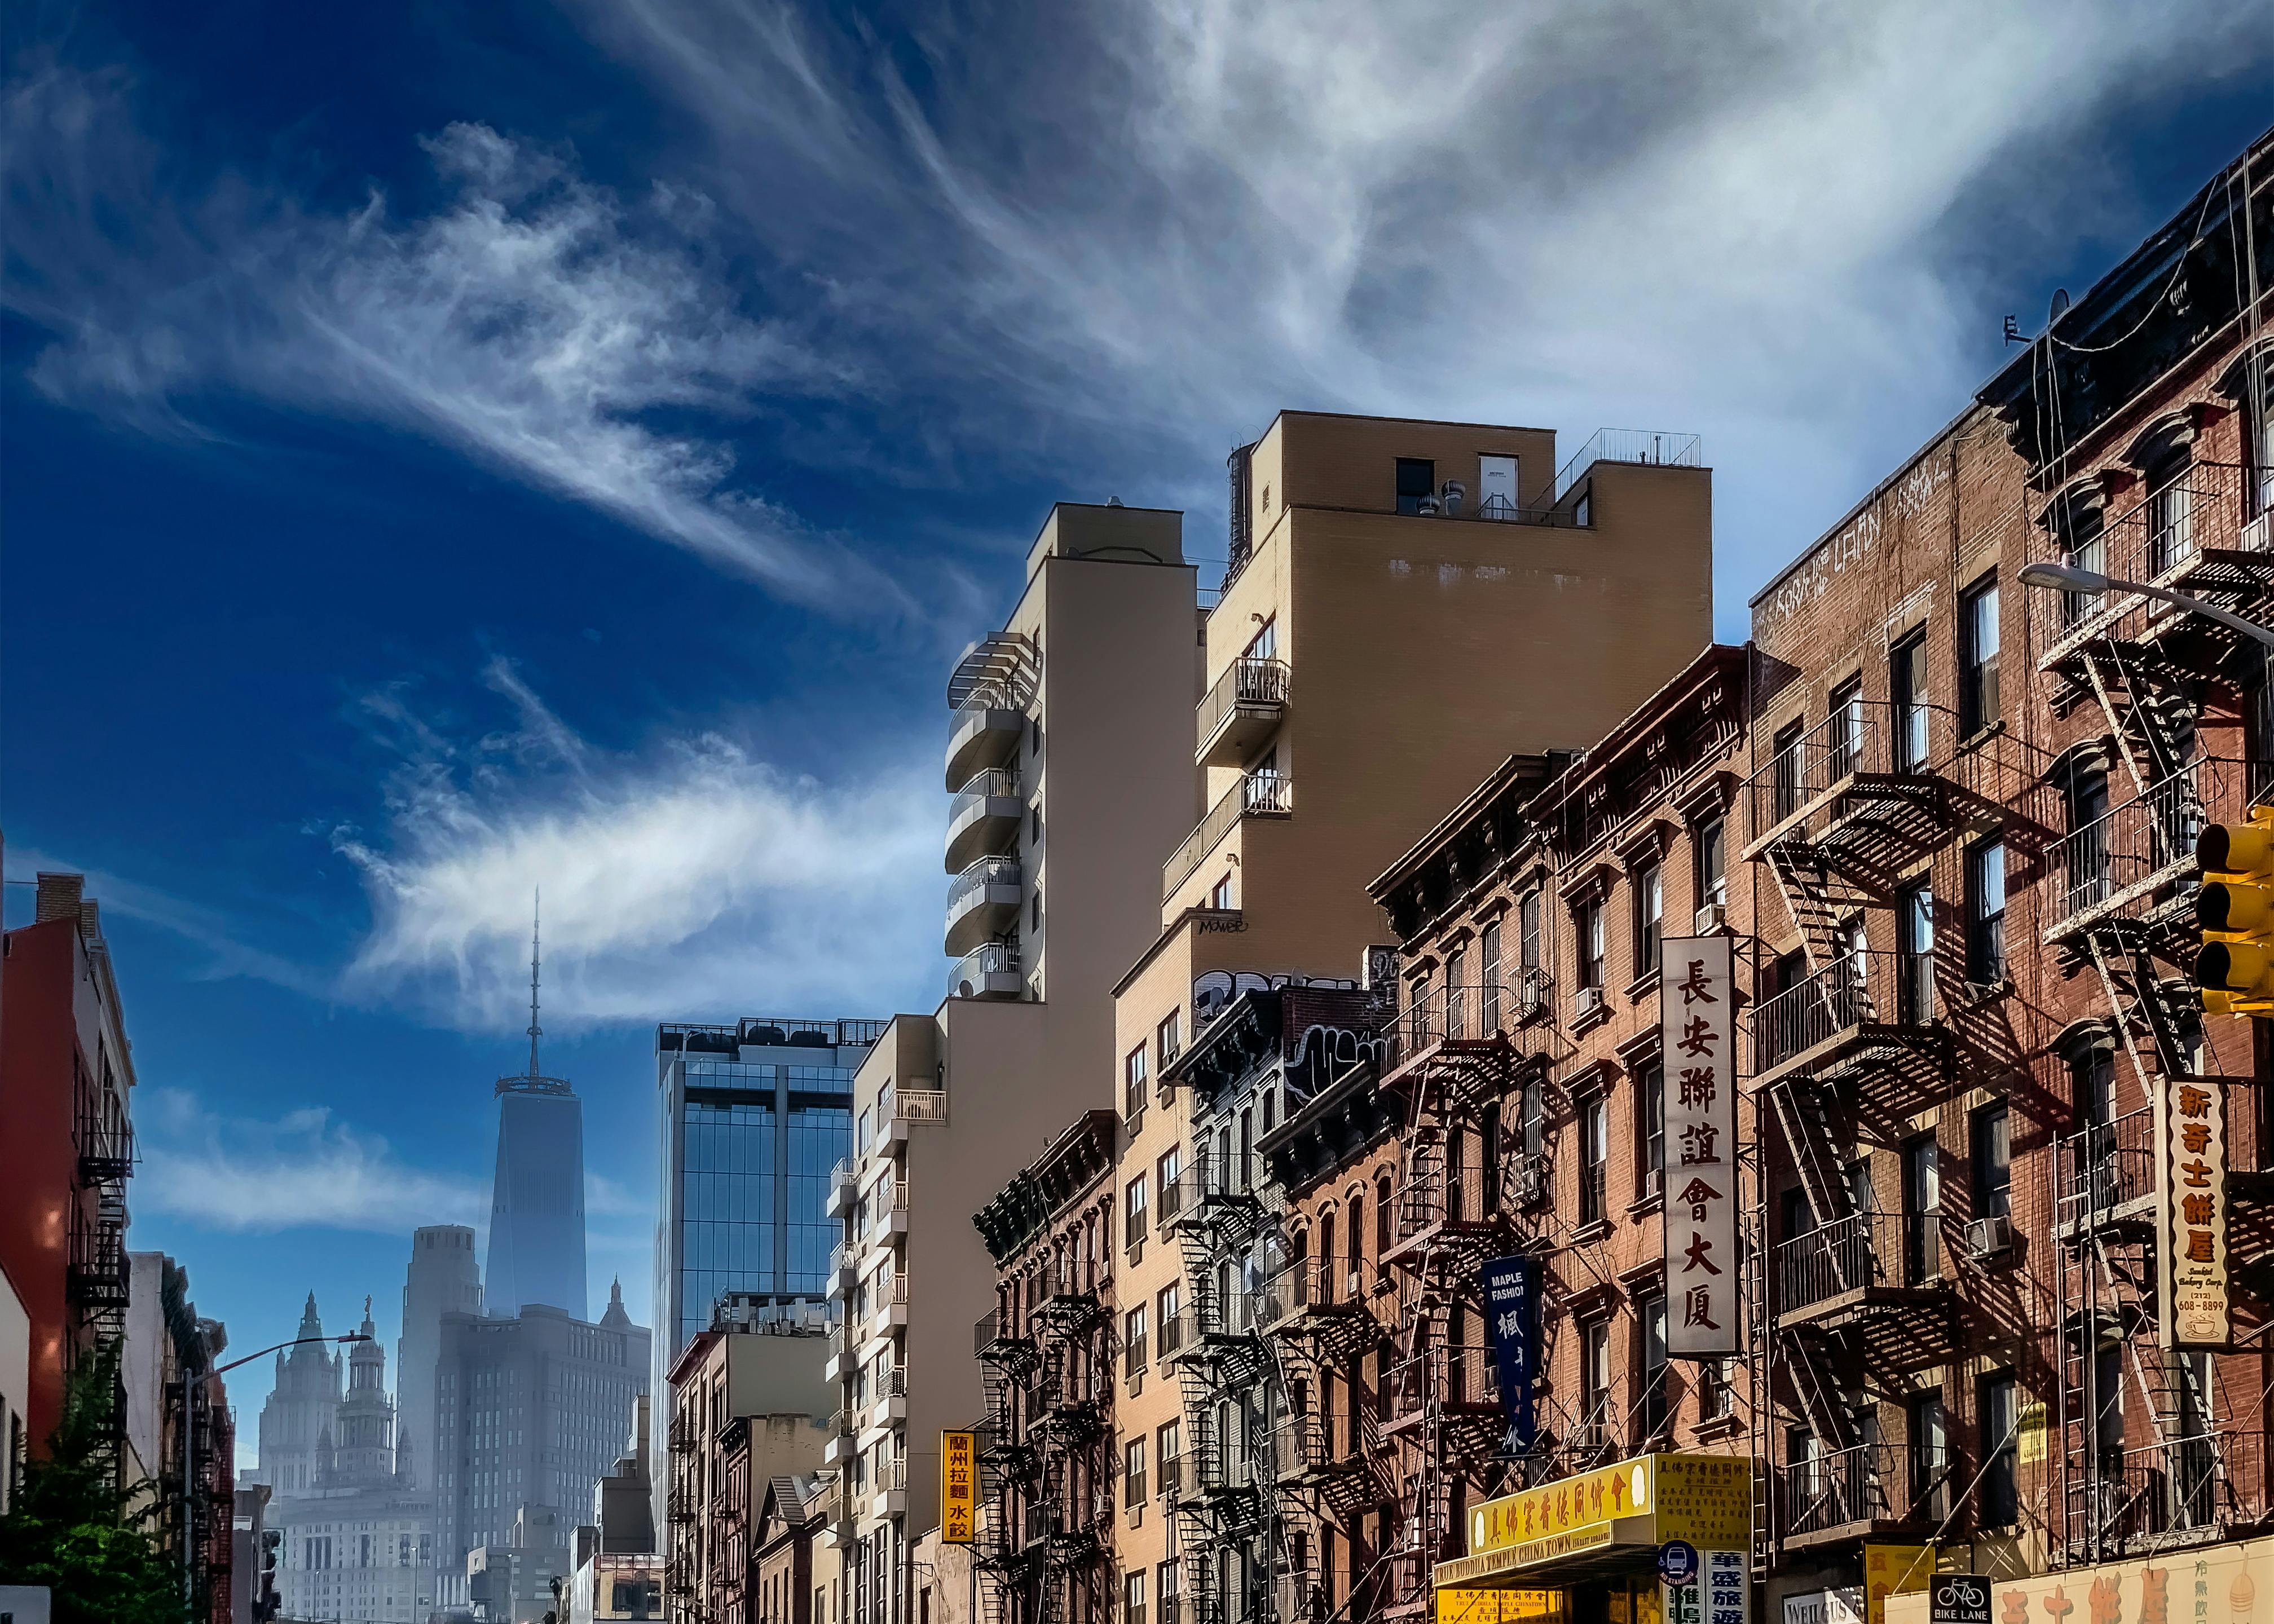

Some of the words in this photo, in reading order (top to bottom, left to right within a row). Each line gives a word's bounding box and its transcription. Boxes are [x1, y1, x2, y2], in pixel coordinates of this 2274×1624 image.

[1676, 959, 1724, 1330] 長安聯誼會大廈
[2178, 1085, 2216, 1263] 新奇士餅屋
[1491, 1272, 1523, 1287] MAPLE
[2178, 1276, 2204, 1290] Bakery
[1434, 1565, 1454, 1583] TRUE
[1456, 1558, 1485, 1578] BUDDHA
[1486, 1548, 1517, 1572] TEMPLE
[1668, 1570, 1694, 1585] STANDING
[1934, 1609, 1958, 1619] BIKE
[1961, 1610, 1988, 1621] LANE
